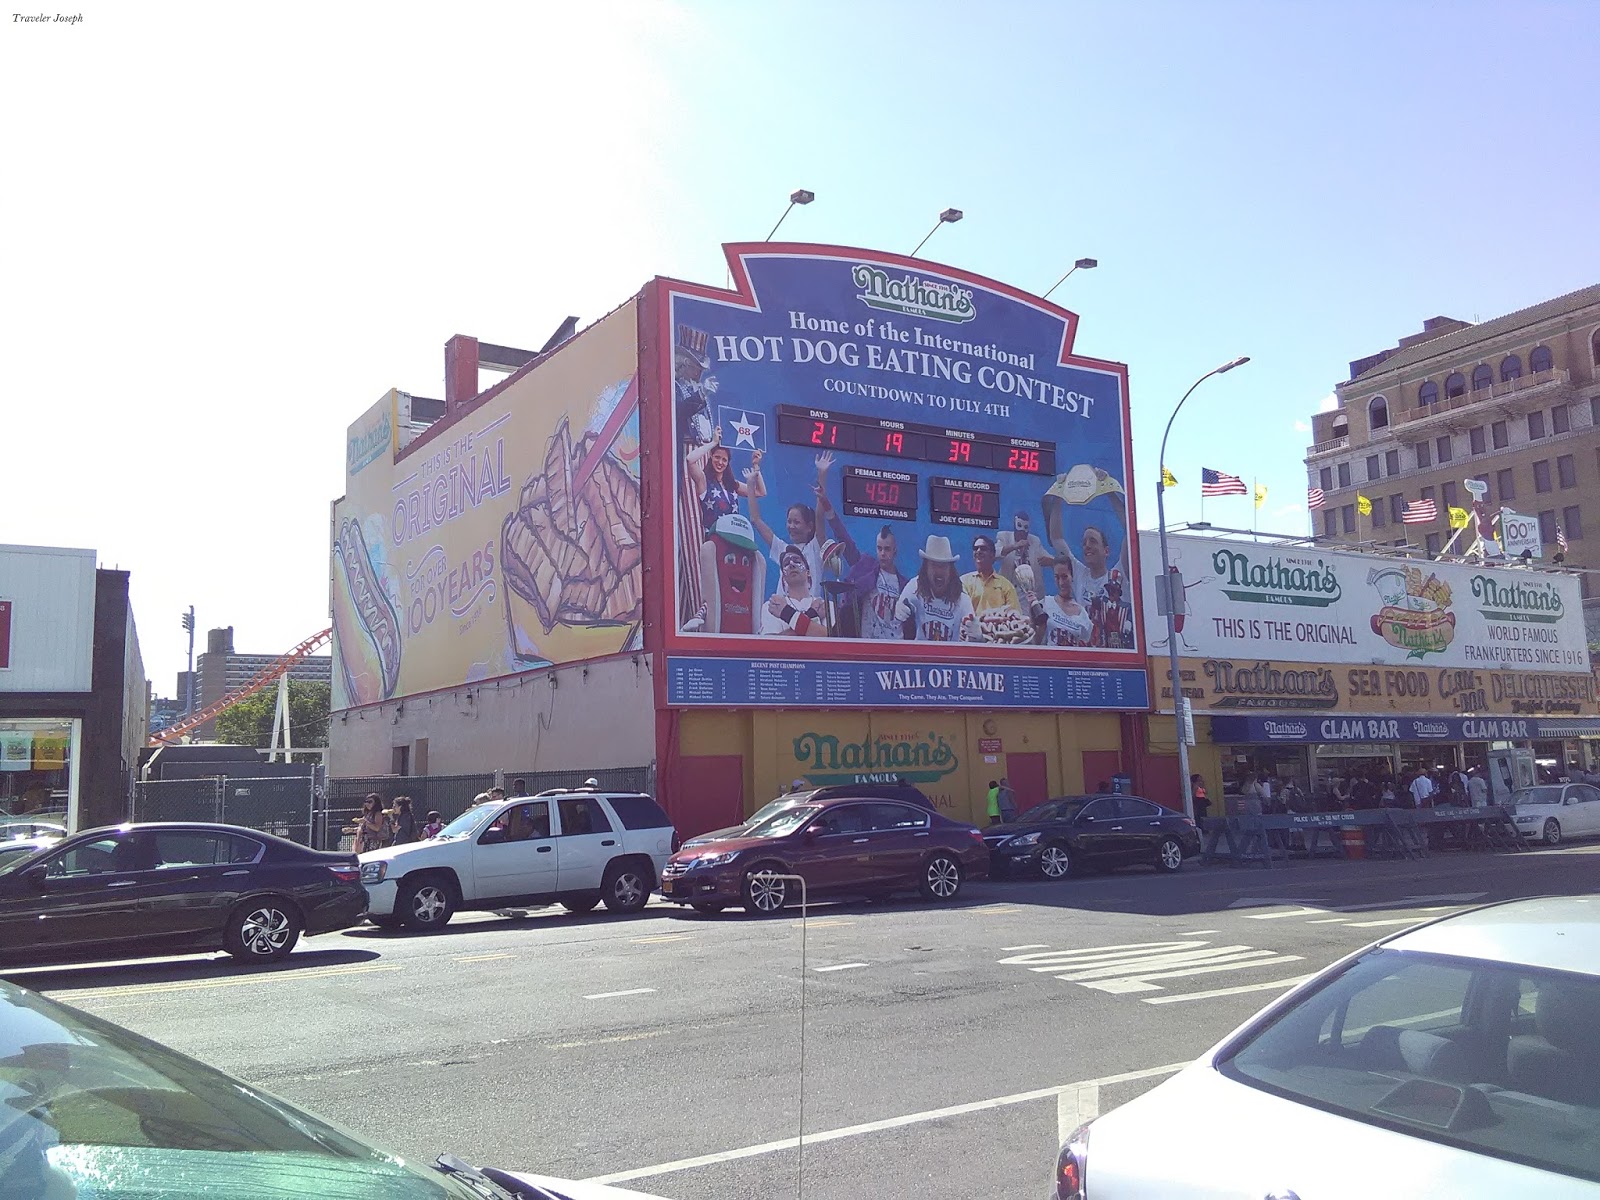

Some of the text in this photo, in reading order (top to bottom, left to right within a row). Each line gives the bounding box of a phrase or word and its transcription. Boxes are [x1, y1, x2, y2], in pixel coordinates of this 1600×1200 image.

[851, 264, 974, 314] Nathan's
[788, 311, 1034, 370] Home of the International
[713, 335, 1095, 419] HOT DOG EATING CONTEST
[823, 378, 1010, 418] COUNTDOWN TO JULY 4TH
[810, 410, 829, 419] DAYS
[880, 420, 905, 429] HOURS
[738, 427, 751, 436] 68
[811, 422, 837, 445] 21
[945, 429, 975, 440] MINUTES
[886, 433, 903, 453] 19
[949, 441, 971, 462] 39
[1010, 438, 1040, 448] SECONDS
[421, 432, 473, 479] THIS IS THE
[855, 468, 911, 481] FEMALE RECORD
[944, 478, 990, 490] MALE RECORD
[391, 437, 512, 547] ORIGINAL
[853, 506, 909, 518] SONYA THOMAS
[938, 514, 993, 526] JOEY CHESTNUT
[1505, 522, 1536, 541] 100TH
[410, 556, 447, 595] FOR OVER
[436, 540, 495, 611] YEARS
[1211, 549, 1337, 594] Nathan's
[1265, 594, 1293, 604] FAMOUS
[1470, 574, 1562, 612] Nathan's
[1212, 617, 1358, 645] THIS IS THE ORIGINAL
[1487, 625, 1559, 644] WORLD FAMOUS
[1464, 645, 1583, 665] FRANKFURTERS SINCE 1916
[875, 669, 926, 691] WALL
[928, 669, 953, 688] OF
[956, 669, 1005, 692] FAME
[1166, 670, 1196, 681] OEN
[1203, 660, 1335, 696] Nathan's
[1349, 669, 1430, 697] SEA FOOD
[1438, 668, 1476, 699] CLAM
[1490, 672, 1600, 704] DELICATESSEN
[1237, 699, 1297, 708] FAMOUS
[1460, 689, 1489, 712] BAR
[1264, 720, 1306, 734] Nathan's
[1320, 720, 1400, 739] CLAM BAR
[1412, 721, 1448, 735] Nathan's
[1462, 720, 1528, 738] CLAM BAR
[792, 730, 954, 770] Nathan's
[855, 773, 898, 784] FAMOUS
